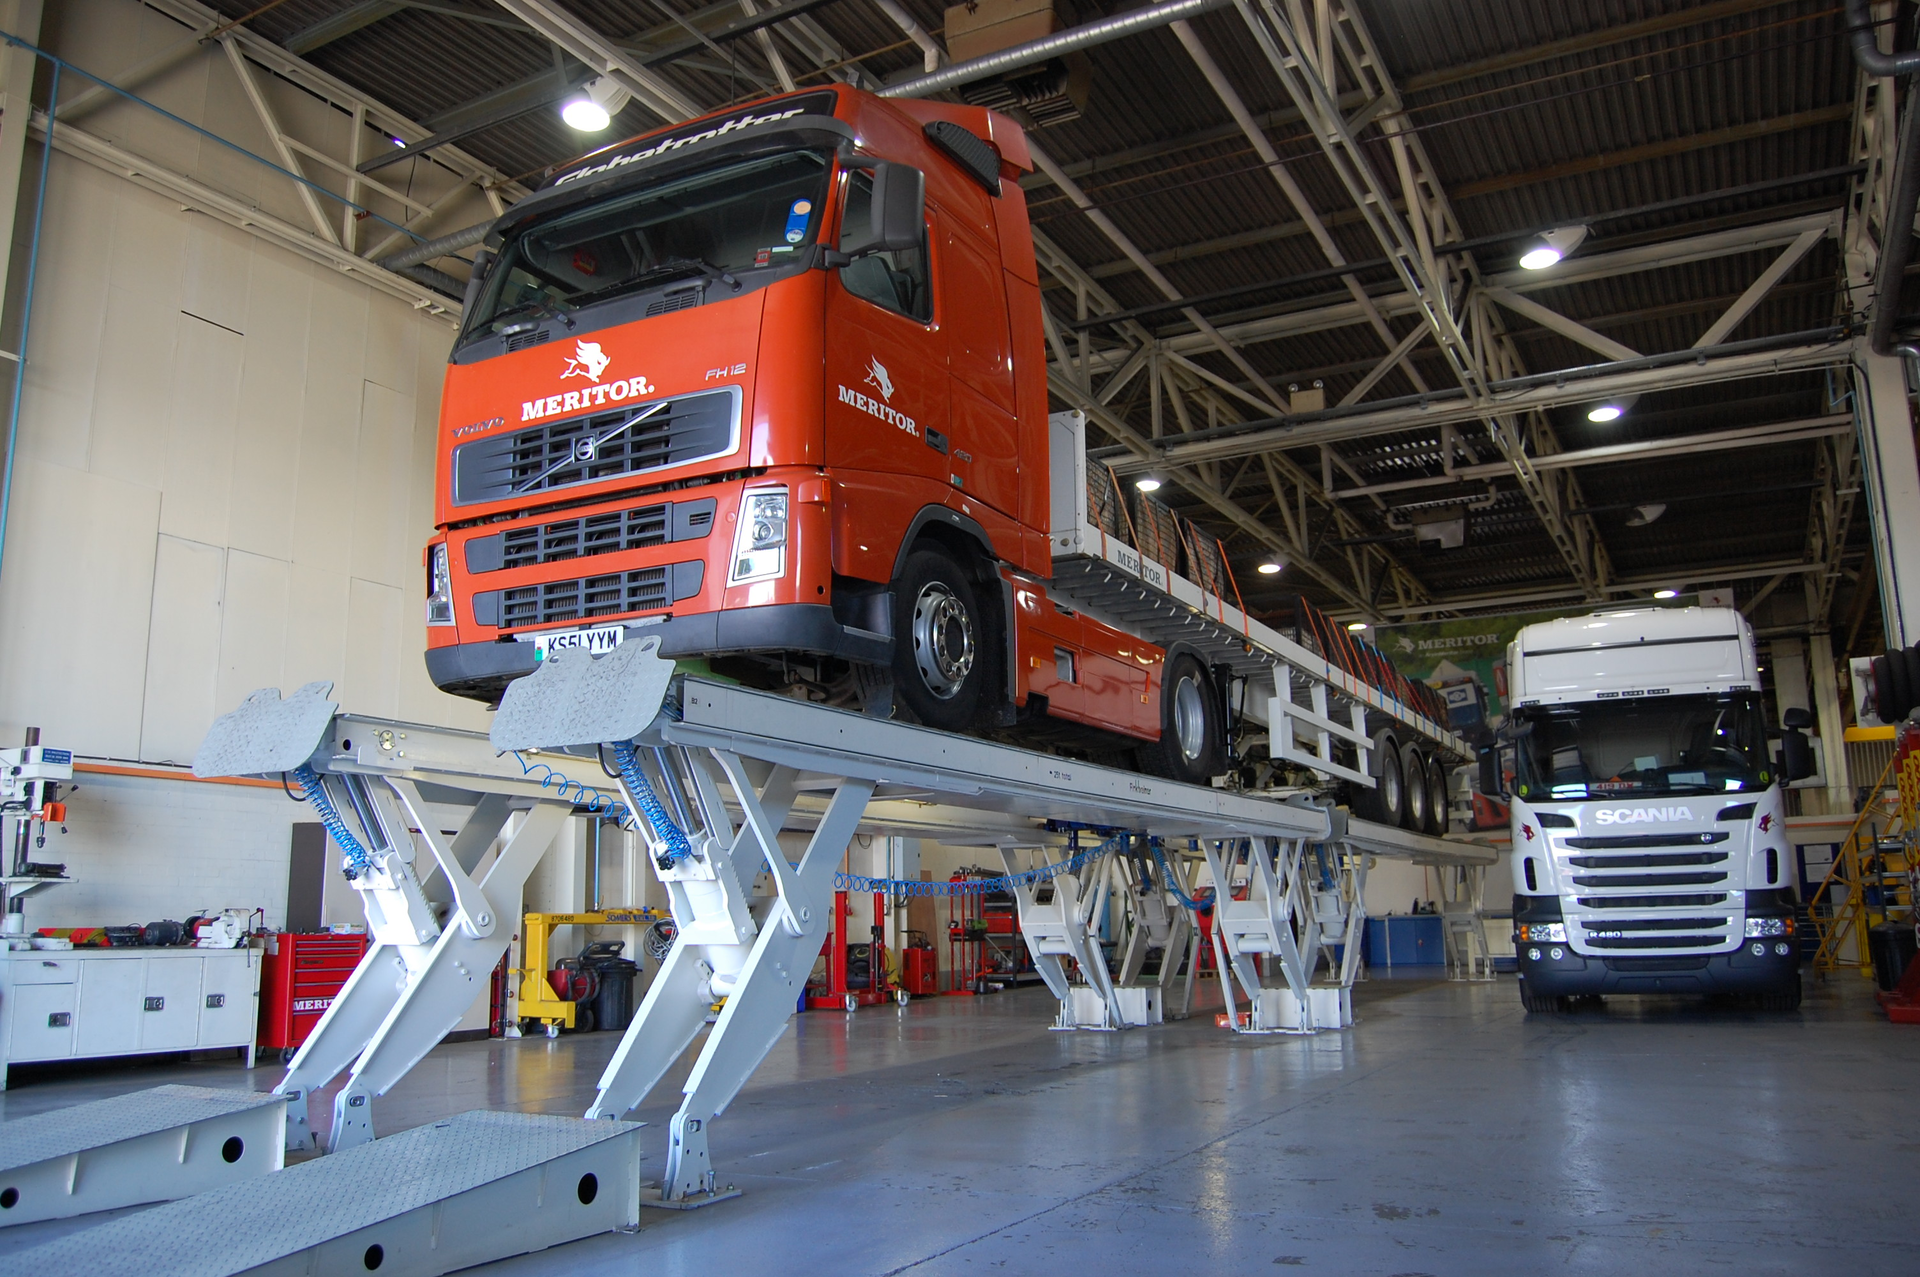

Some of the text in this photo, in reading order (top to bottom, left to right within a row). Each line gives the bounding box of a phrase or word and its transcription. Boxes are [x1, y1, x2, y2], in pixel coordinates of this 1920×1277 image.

[451, 416, 505, 438] VOLVO
[1117, 549, 1162, 586] MERTOR
[586, 629, 617, 651] YYM
[1418, 633, 1499, 651] MERITOR
[1595, 806, 1694, 825] SCANIA
